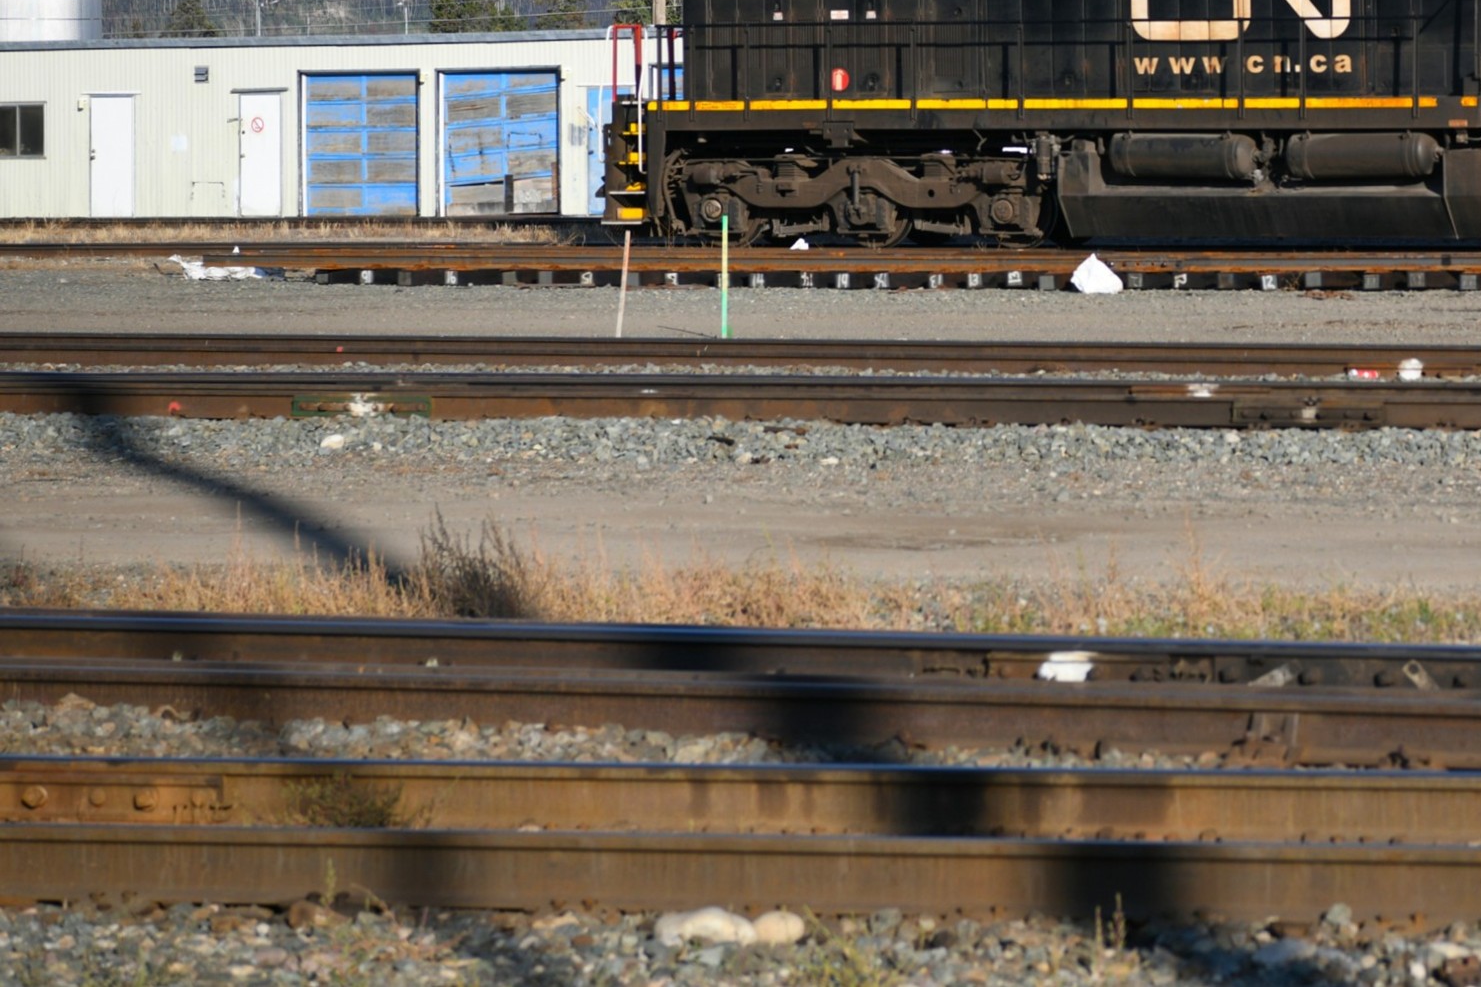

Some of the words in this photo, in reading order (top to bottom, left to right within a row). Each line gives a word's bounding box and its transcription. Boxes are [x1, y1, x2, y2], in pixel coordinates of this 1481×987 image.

[1134, 53, 1352, 75] wwwcn.ca
[752, 273, 765, 286] 14
[968, 273, 980, 287] 13
[1261, 275, 1276, 289] 12
